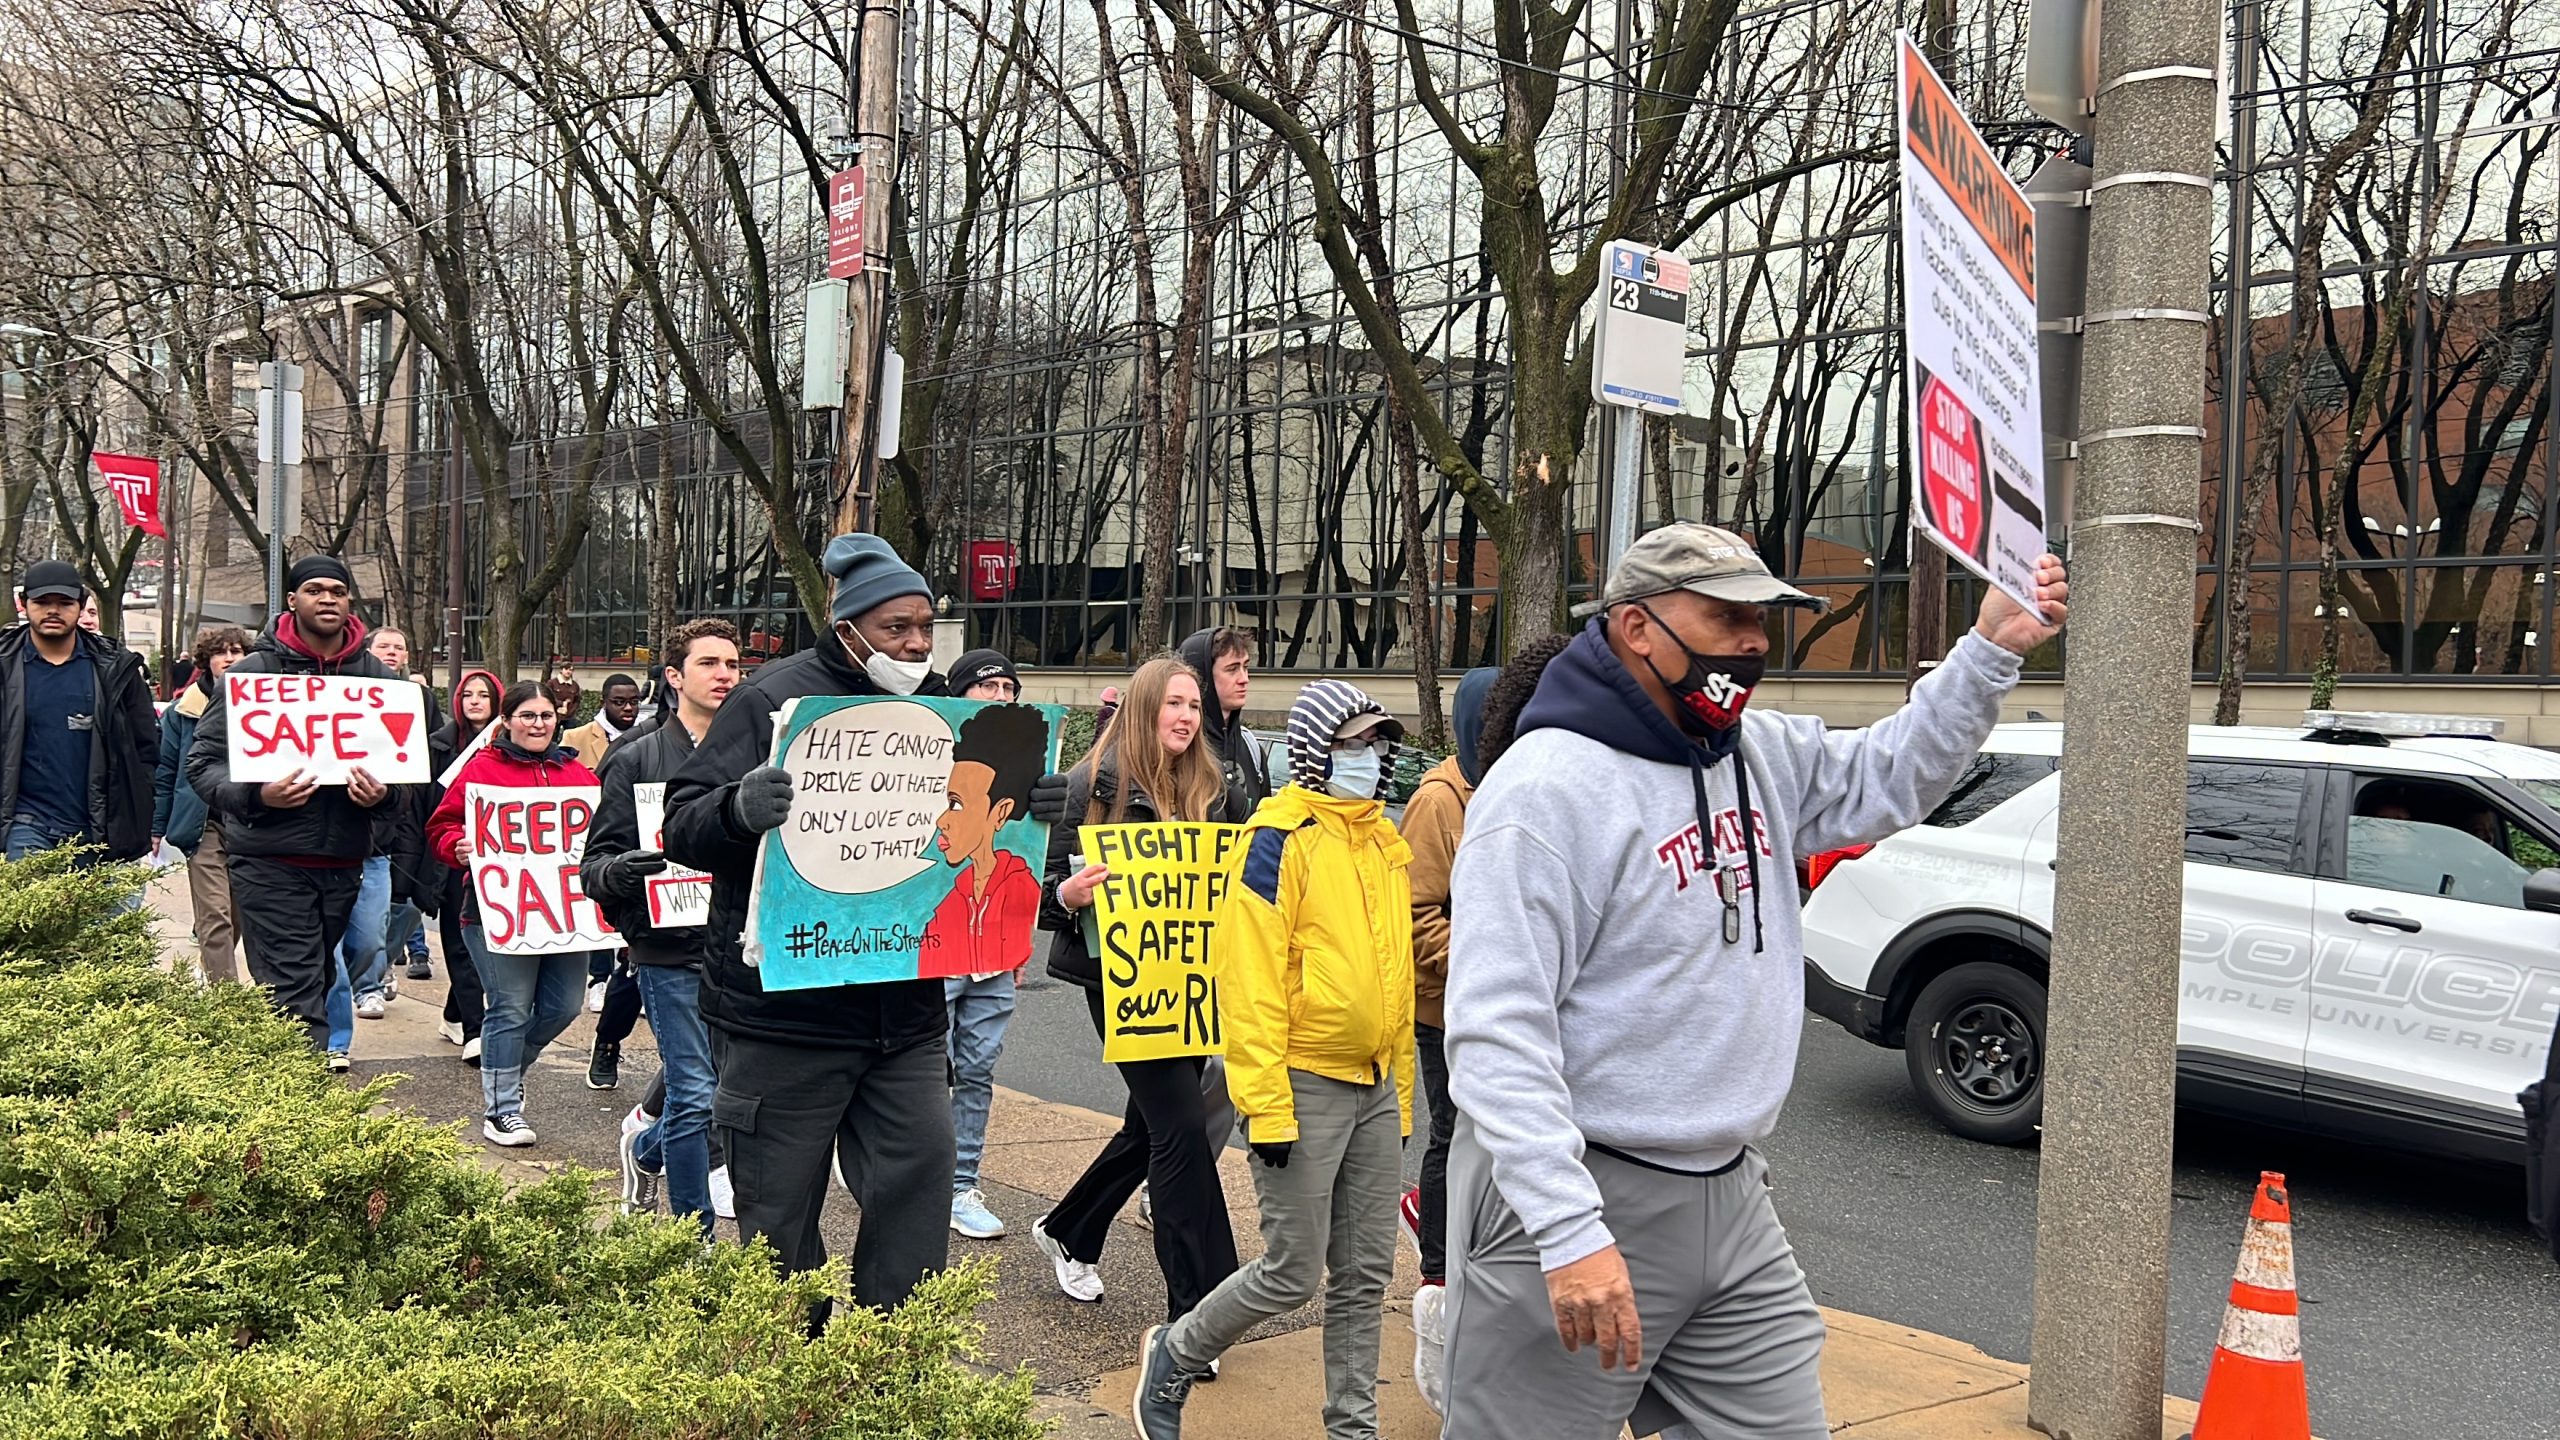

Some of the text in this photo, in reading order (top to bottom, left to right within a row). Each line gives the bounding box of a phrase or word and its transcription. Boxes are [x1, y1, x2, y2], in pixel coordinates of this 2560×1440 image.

[1935, 98, 2034, 286] WARNING
[834, 223, 859, 237] FLIGHT
[1611, 278, 1640, 312] 23
[1921, 229, 1973, 314] hazardous
[1985, 311, 2004, 350] your
[1949, 224, 2003, 312] Philadelphia
[2004, 299, 2027, 341] could
[1931, 285, 1952, 328] due
[1964, 320, 1980, 360] the
[1981, 339, 2018, 401] increase
[1952, 346, 1973, 391] Gun
[1935, 387, 1966, 447] STOP
[1929, 430, 1977, 503] KILLING
[1946, 491, 1965, 541] US
[229, 676, 326, 707] KEEP
[883, 731, 952, 760] CANNOT
[800, 770, 863, 793] DRIVE
[870, 771, 906, 793] OUT
[474, 796, 594, 858] KEEP
[799, 810, 932, 834] ONLY LOVE CAN
[1095, 827, 1201, 864] FIGHT
[840, 844, 867, 861] DO
[663, 881, 710, 913] WHA
[1103, 871, 1201, 913] FIGHT
[1105, 919, 1219, 989] SAFET
[1116, 972, 1222, 1047] our RI
[2183, 982, 2546, 1058] MPLE UNIVERSI
